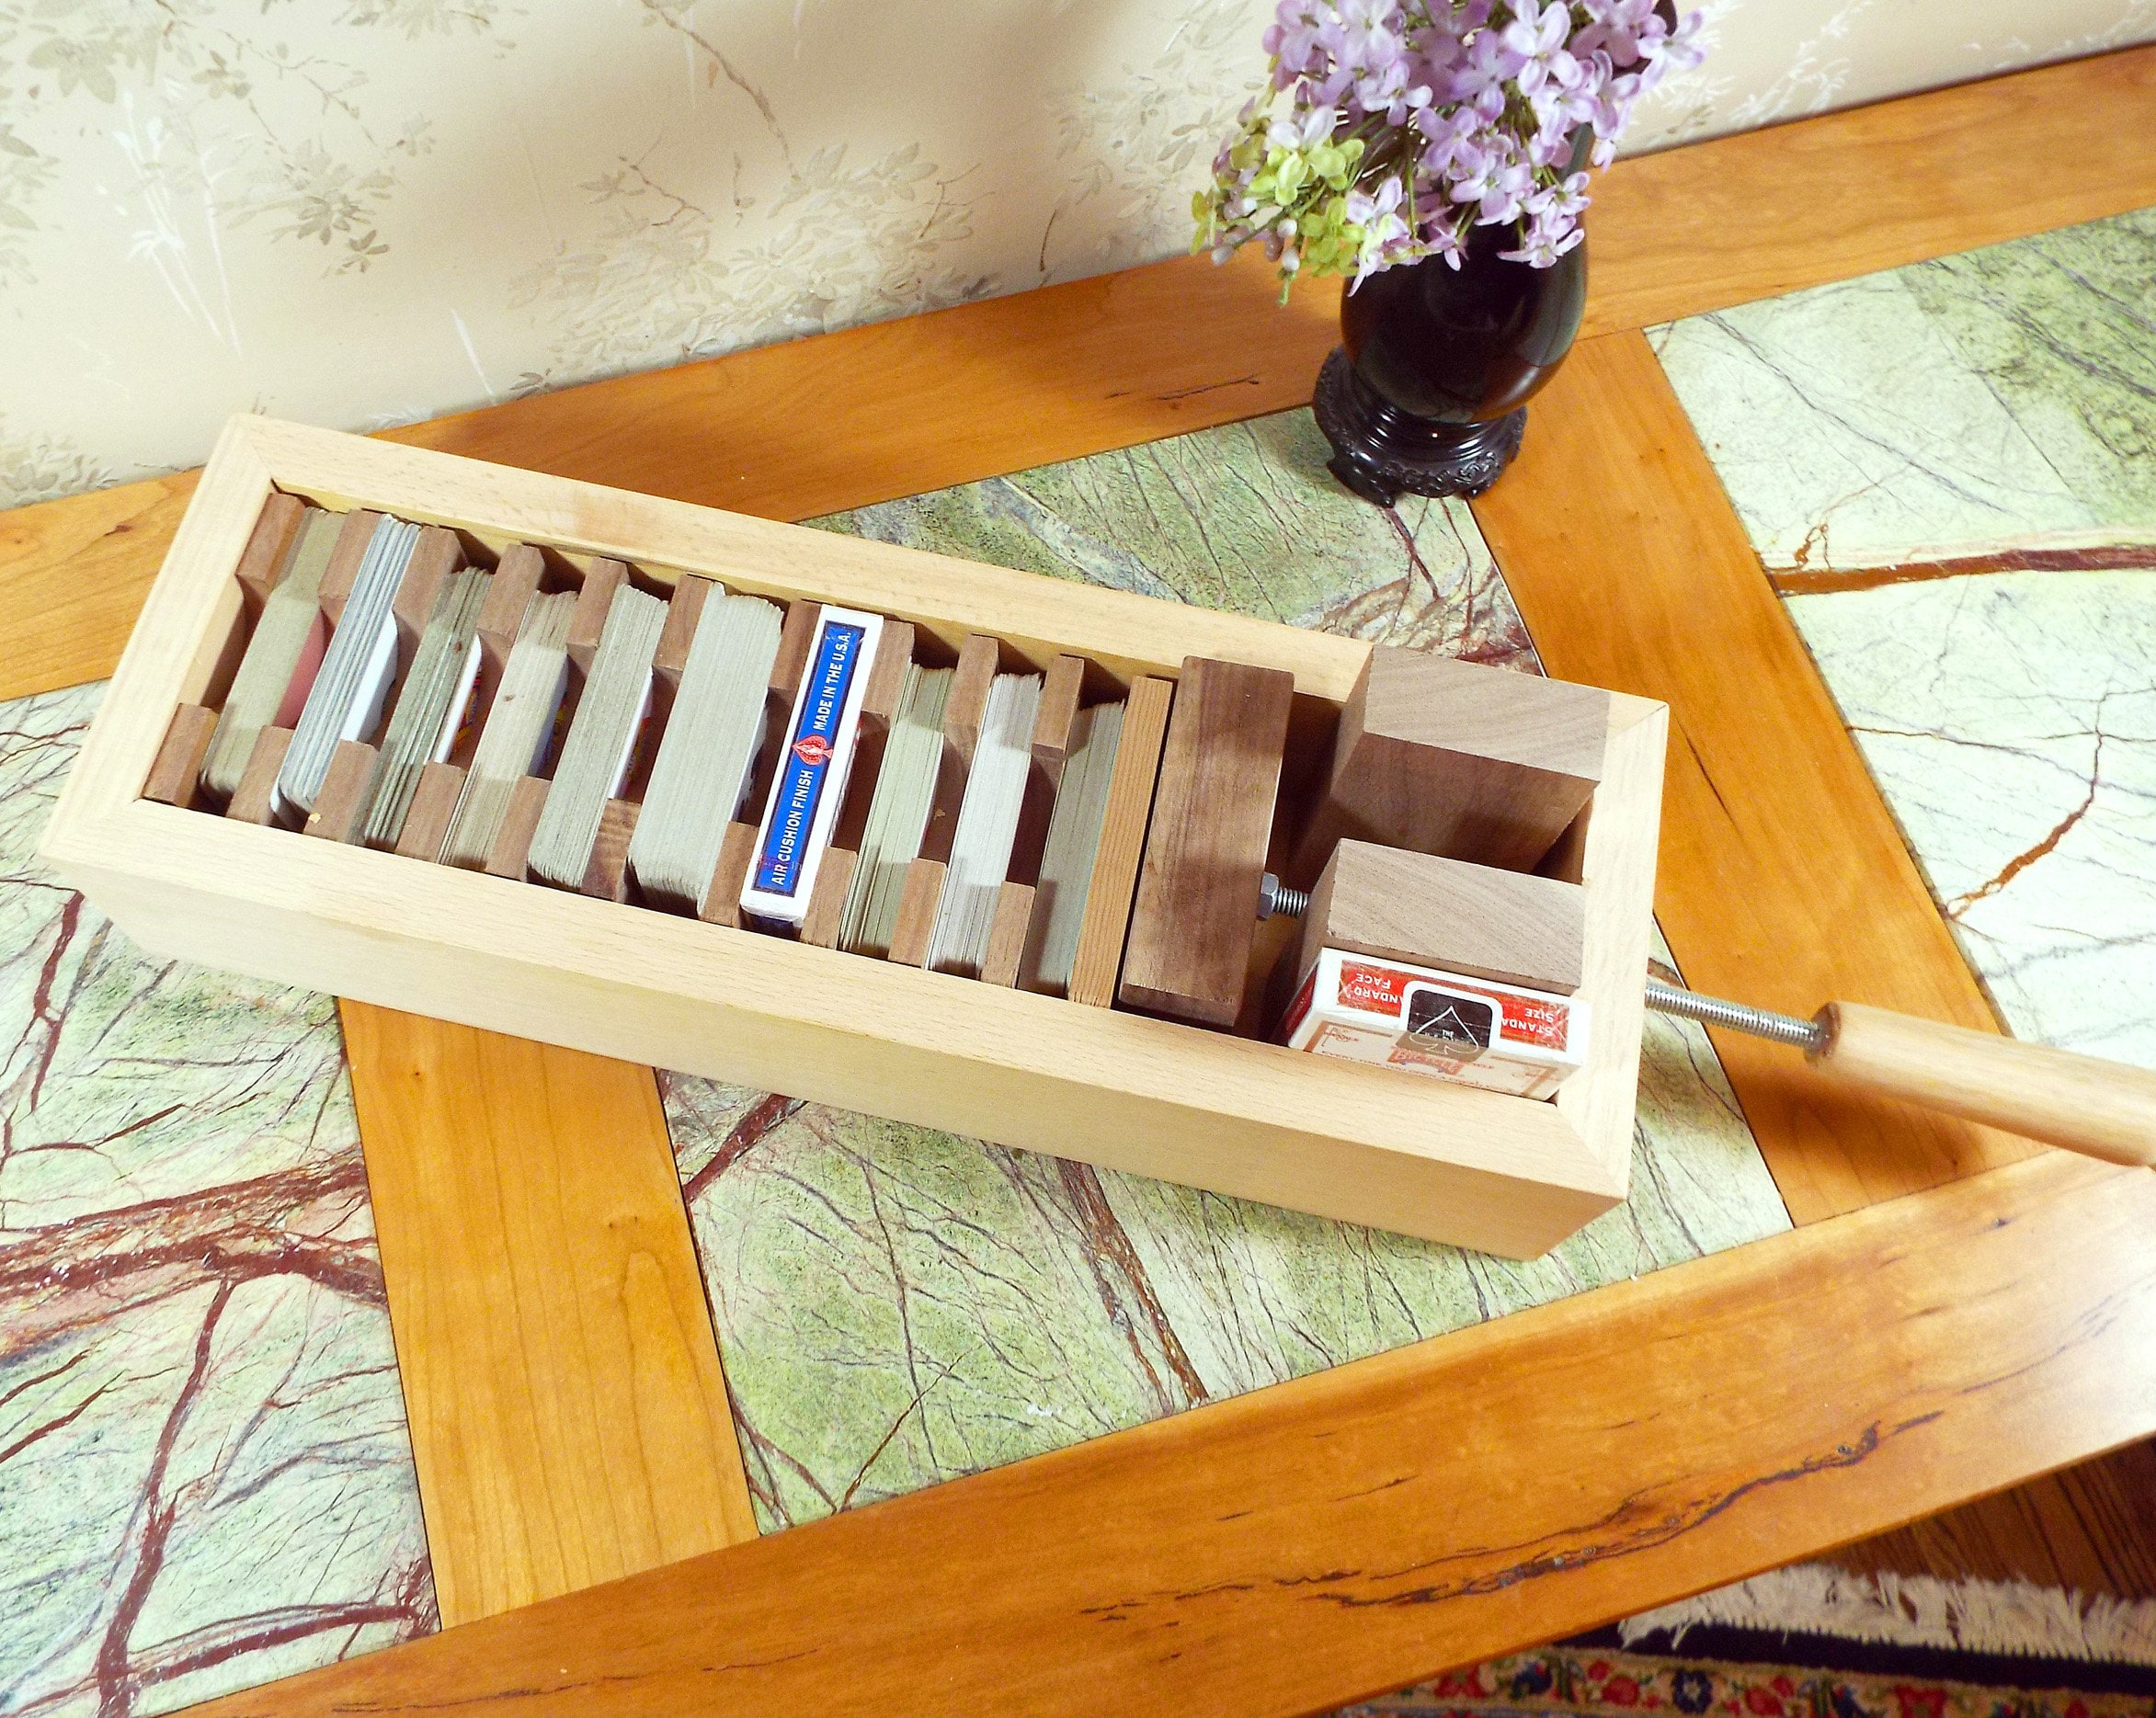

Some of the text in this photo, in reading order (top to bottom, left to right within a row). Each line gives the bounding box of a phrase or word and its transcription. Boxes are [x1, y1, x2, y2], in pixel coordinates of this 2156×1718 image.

[813, 631, 852, 731] MADE IN THE U.S.A.
[770, 769, 814, 886] AIR CUSHION FINISH
[1355, 973, 1391, 990] FACE
[1524, 1007, 1555, 1024] SIZE
